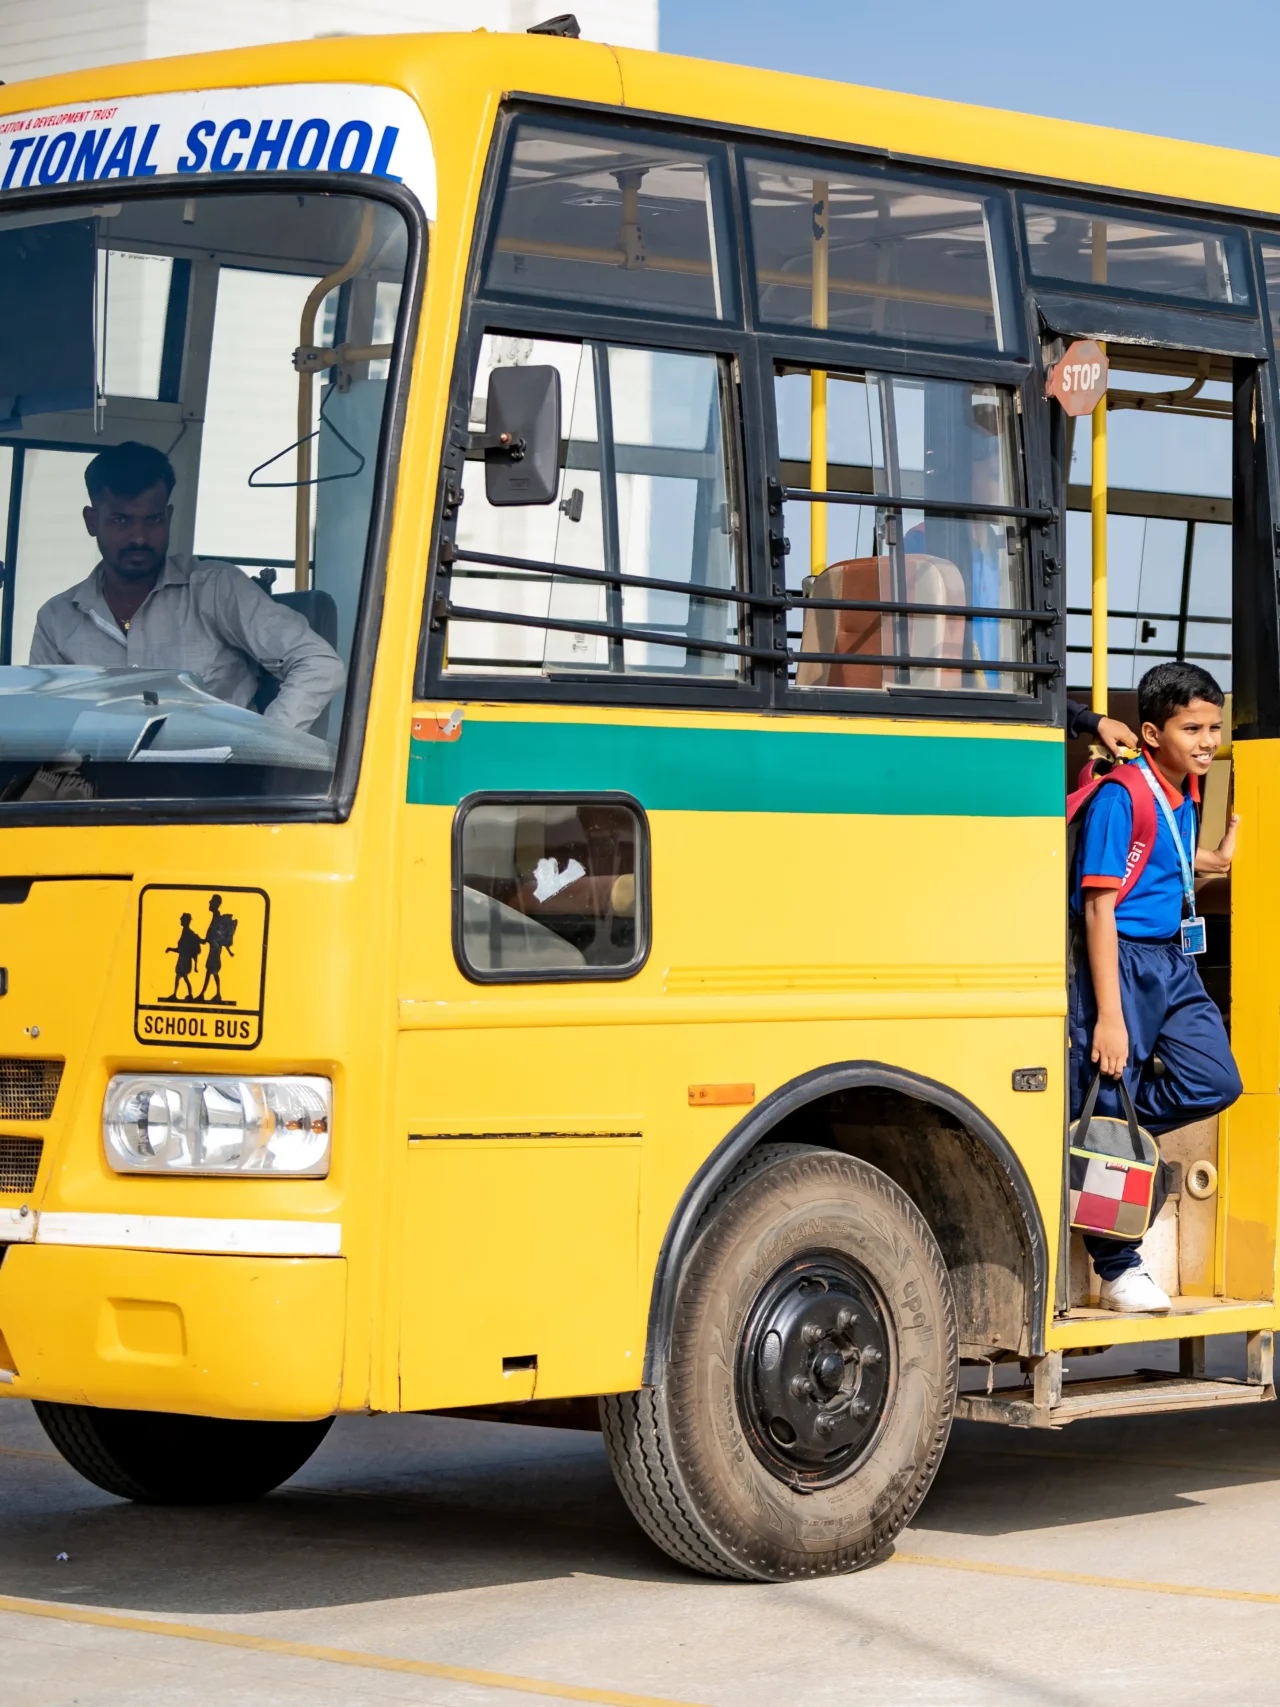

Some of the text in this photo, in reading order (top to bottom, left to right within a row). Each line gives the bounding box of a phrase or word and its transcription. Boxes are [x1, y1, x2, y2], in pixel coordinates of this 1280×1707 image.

[25, 118, 33, 130] &
[33, 111, 91, 128] DEVELOPMENT
[91, 107, 119, 121] TRUST
[0, 118, 403, 191] TIONAL SCHOOL
[1062, 363, 1101, 392] STOP
[144, 1016, 250, 1039] SCHOOL BUS
